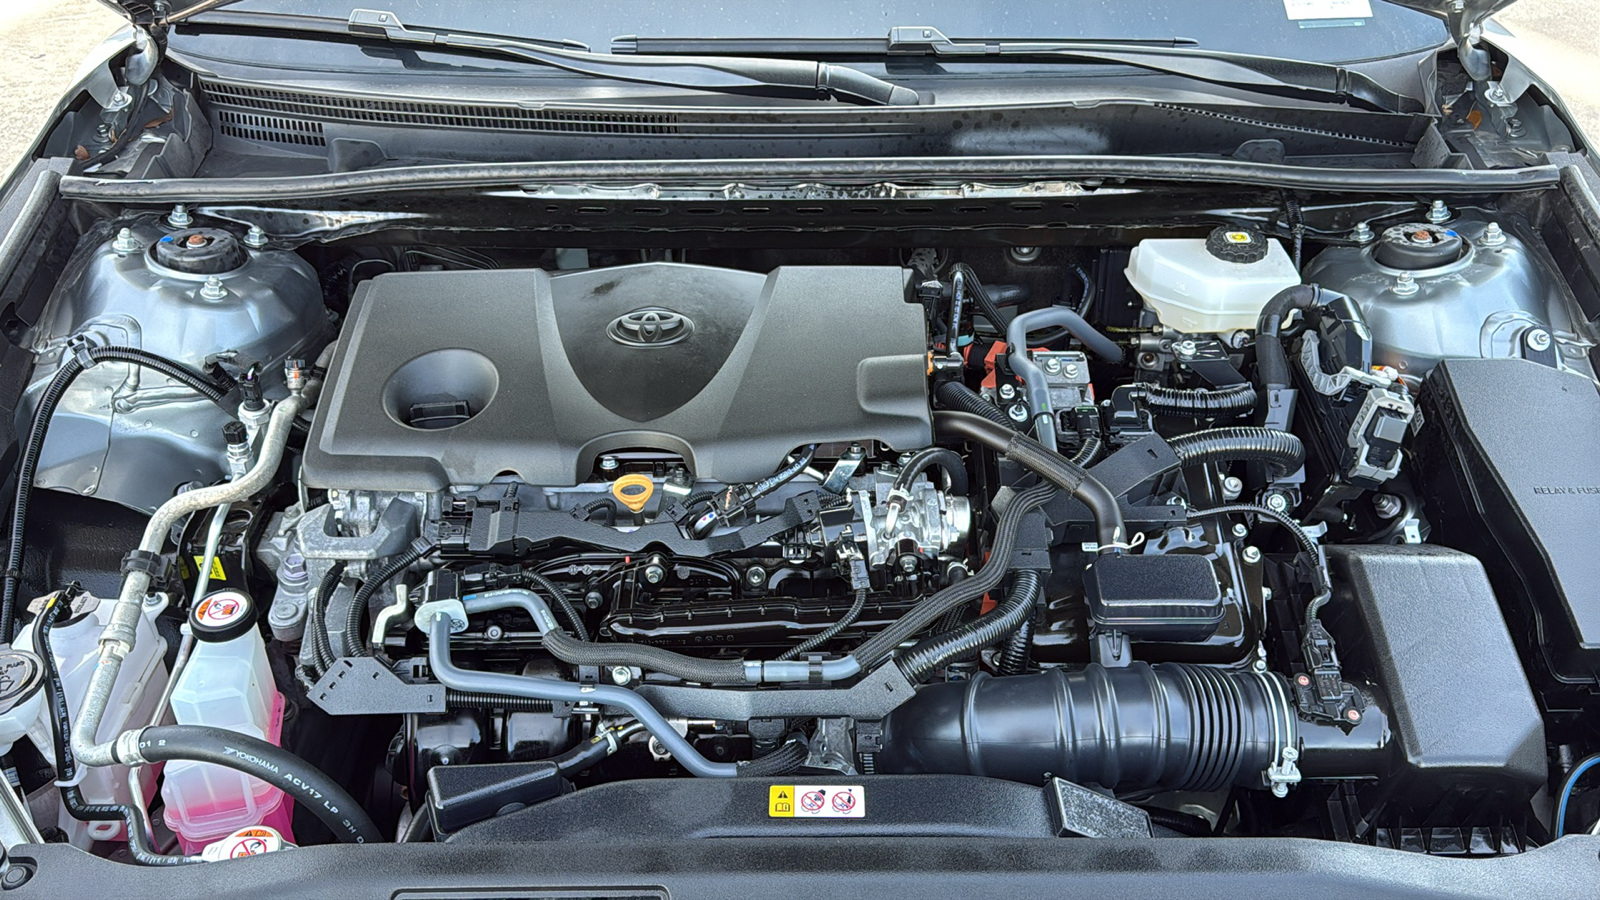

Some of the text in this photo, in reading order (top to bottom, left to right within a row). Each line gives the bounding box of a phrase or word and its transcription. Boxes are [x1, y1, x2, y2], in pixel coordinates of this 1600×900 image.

[1532, 486, 1600, 495] RELAY & FUSE
[234, 749, 279, 773] YOKOHAMA
[284, 772, 322, 799] ACV17
[323, 800, 339, 814] LP
